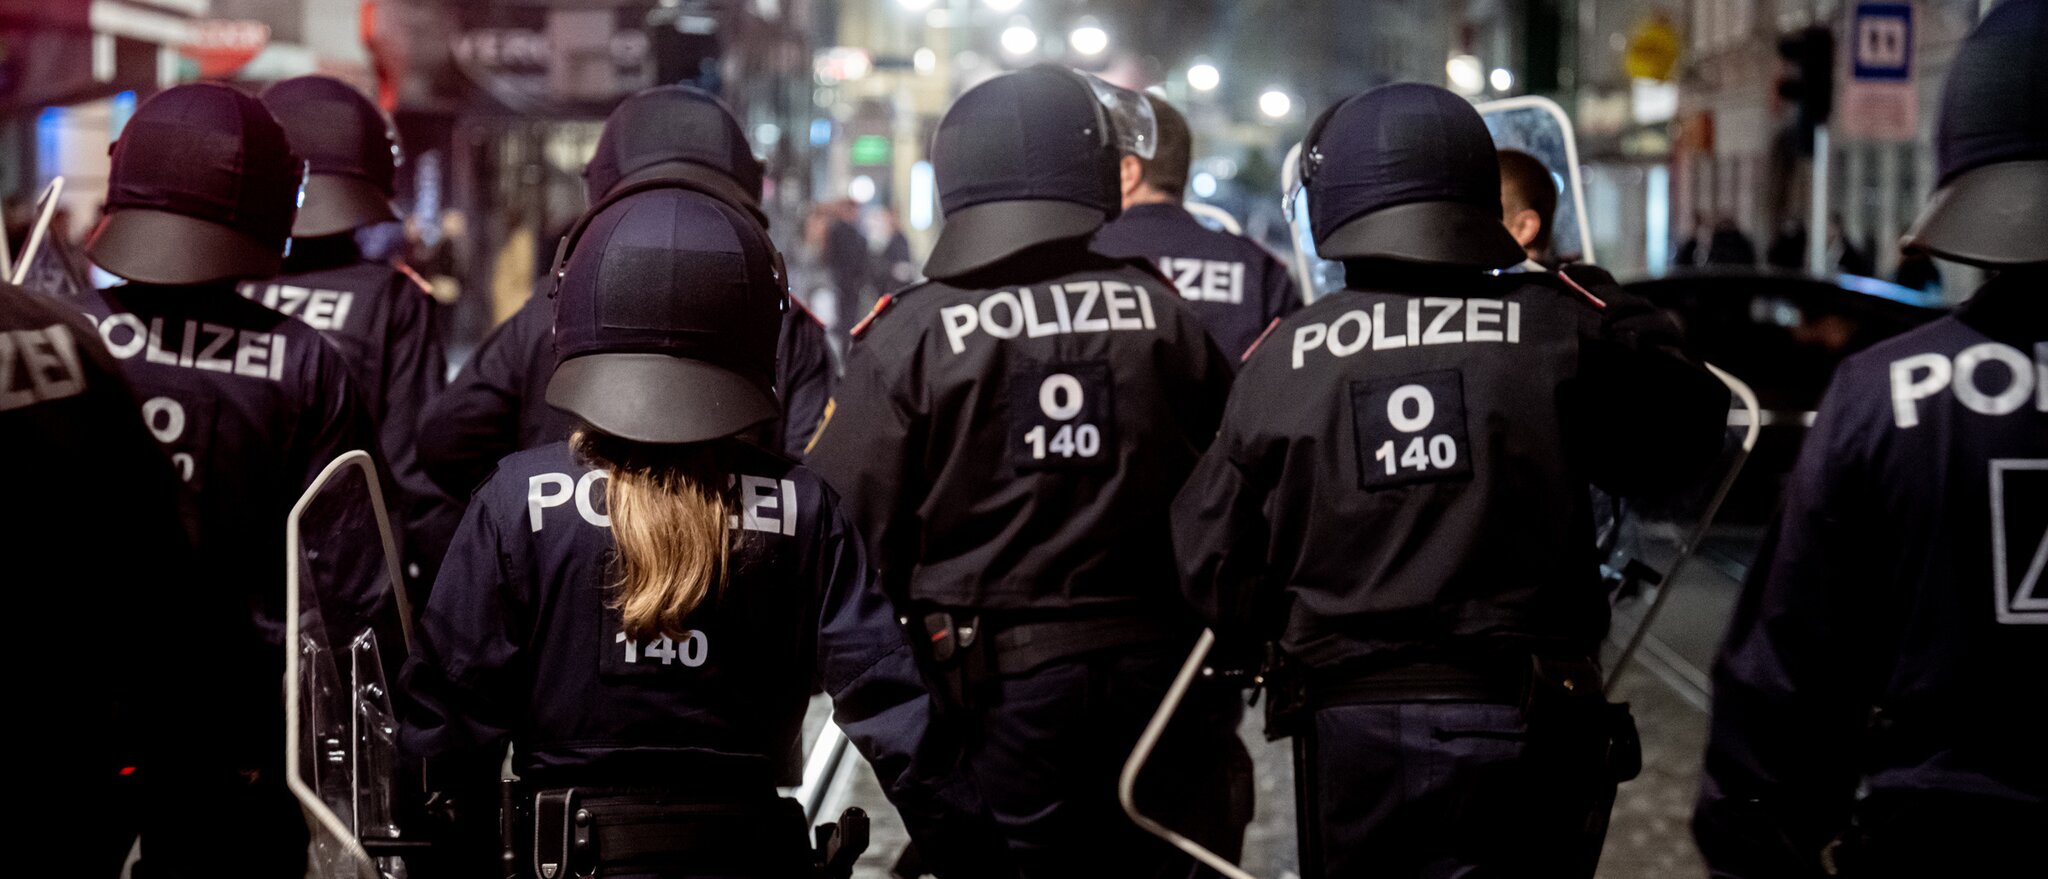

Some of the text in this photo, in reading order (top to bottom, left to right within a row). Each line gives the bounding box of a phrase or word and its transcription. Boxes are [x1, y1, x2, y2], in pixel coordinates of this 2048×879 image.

[82, 312, 287, 381] OLIZEI
[940, 281, 1157, 355] POLIZEI
[1292, 297, 1521, 370] POLIZEI
[1024, 423, 1100, 460] 140
[1375, 433, 1457, 476] 140
[528, 469, 798, 537] POEI
[615, 629, 708, 668] 140
